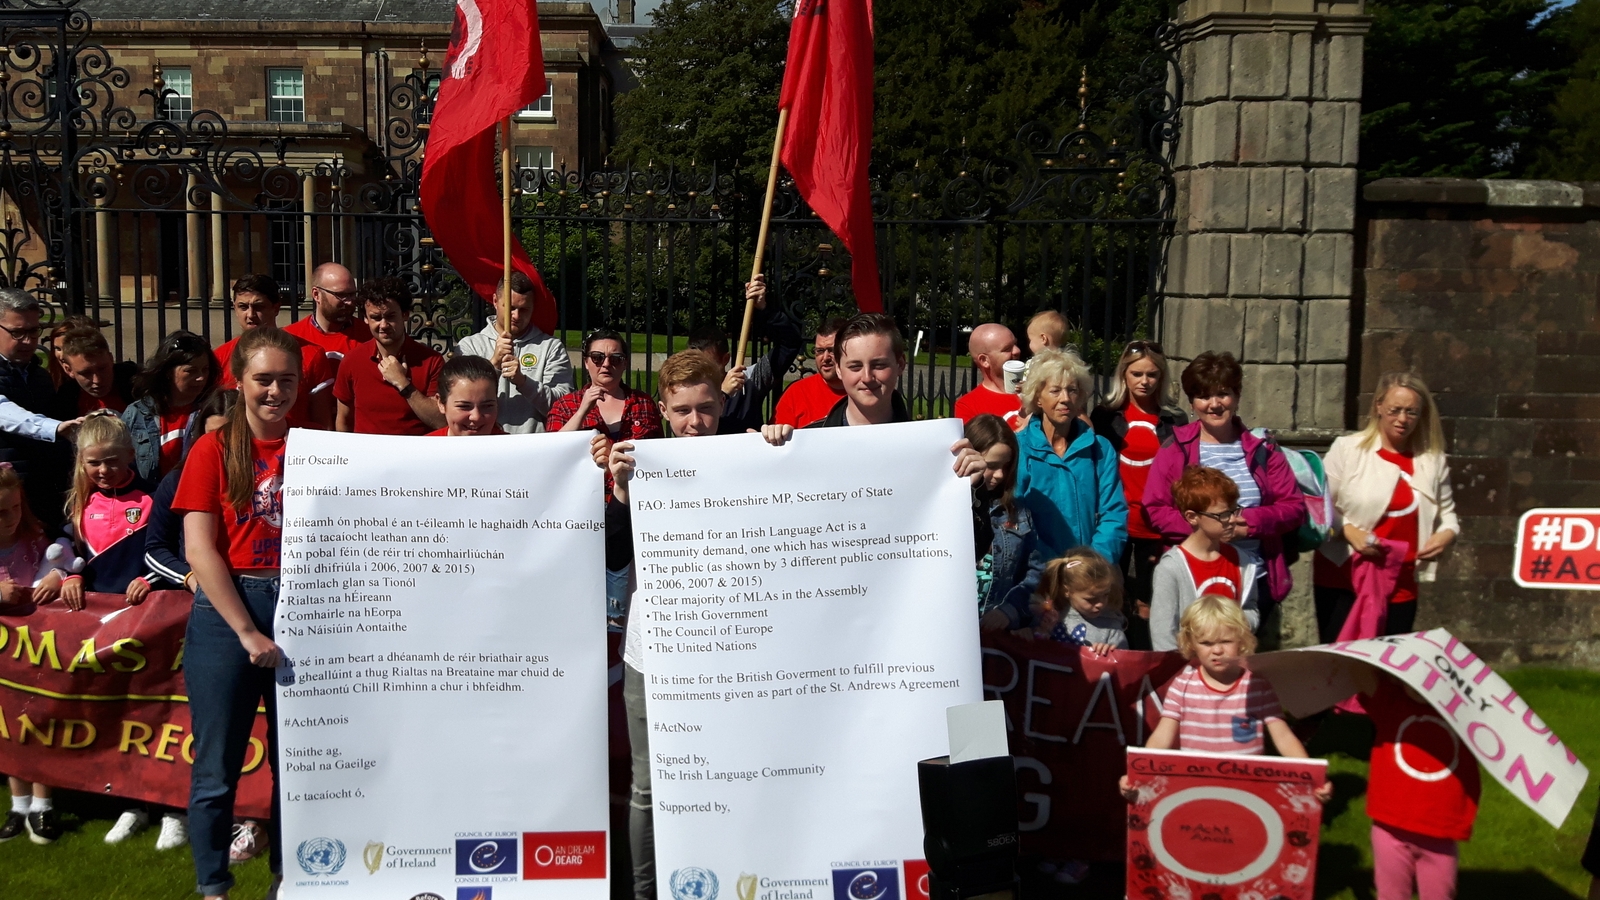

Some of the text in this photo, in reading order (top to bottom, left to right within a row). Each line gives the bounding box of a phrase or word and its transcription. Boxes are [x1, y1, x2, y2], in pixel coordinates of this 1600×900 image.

[288, 455, 306, 465] Litir
[308, 455, 349, 465] Oscailte
[635, 468, 697, 481] Open Letter
[306, 486, 342, 496] bhráid:
[344, 486, 377, 497] James
[380, 487, 444, 498] Brokenshire
[447, 488, 468, 499] MP,
[471, 488, 501, 498] Rúnaí
[505, 488, 529, 499] Stáit
[638, 487, 893, 511] FAO: James Brokenshire MP, Secretary of State
[640, 521, 866, 542] The demand for an Irish Language Act is a
[1531, 516, 1600, 551] #D
[287, 550, 303, 559] An
[306, 547, 336, 559] pobal
[340, 546, 360, 557] féin
[361, 546, 380, 559] (de
[382, 547, 401, 558] réir
[403, 548, 415, 558] trí
[364, 561, 367, 572] i
[371, 561, 400, 574] 2006,
[402, 562, 428, 573] 2007
[431, 563, 441, 573] &
[444, 563, 475, 575] 2015)
[287, 576, 416, 590] Tromlach glan sa Tionól
[644, 575, 762, 590] in 2006, 2007 & 2015)
[287, 589, 392, 606] Rialtas na hÉireann
[650, 584, 868, 607] Clear majority of MLAs in the Assembly
[287, 606, 402, 622] Comhairle na hEorpa
[653, 608, 768, 622] The Irish Government
[288, 626, 304, 637] Na
[354, 621, 407, 632] Aontaithe
[653, 624, 773, 637] The Council of Europe
[654, 640, 757, 653] The United Nations
[299, 656, 311, 667] sé
[315, 655, 325, 666] in
[328, 656, 345, 665] am
[348, 653, 375, 663] beart
[386, 652, 440, 662] dhéanamh
[443, 652, 455, 662] de
[458, 653, 476, 662] réir
[479, 653, 523, 663] briathair
[525, 655, 549, 665] agus
[651, 662, 935, 685] It is time for the British Goverment to fulfill previous
[1434, 655, 1493, 712] ONLY
[284, 714, 349, 727] #AchtAnois
[654, 722, 702, 732] #ActNow
[286, 761, 316, 772] Pobal
[334, 758, 376, 770] Gaeilge
[656, 753, 709, 767] Signed by,
[657, 763, 825, 782] The Irish Language Community
[1187, 764, 1212, 774] an
[287, 792, 301, 802] Le
[659, 801, 730, 815] Supported by,
[386, 846, 452, 856] Government
[386, 857, 436, 868] of Ireland
[555, 856, 583, 866] DEARG
[760, 877, 828, 888] Government
[761, 889, 813, 900] of Ireland
